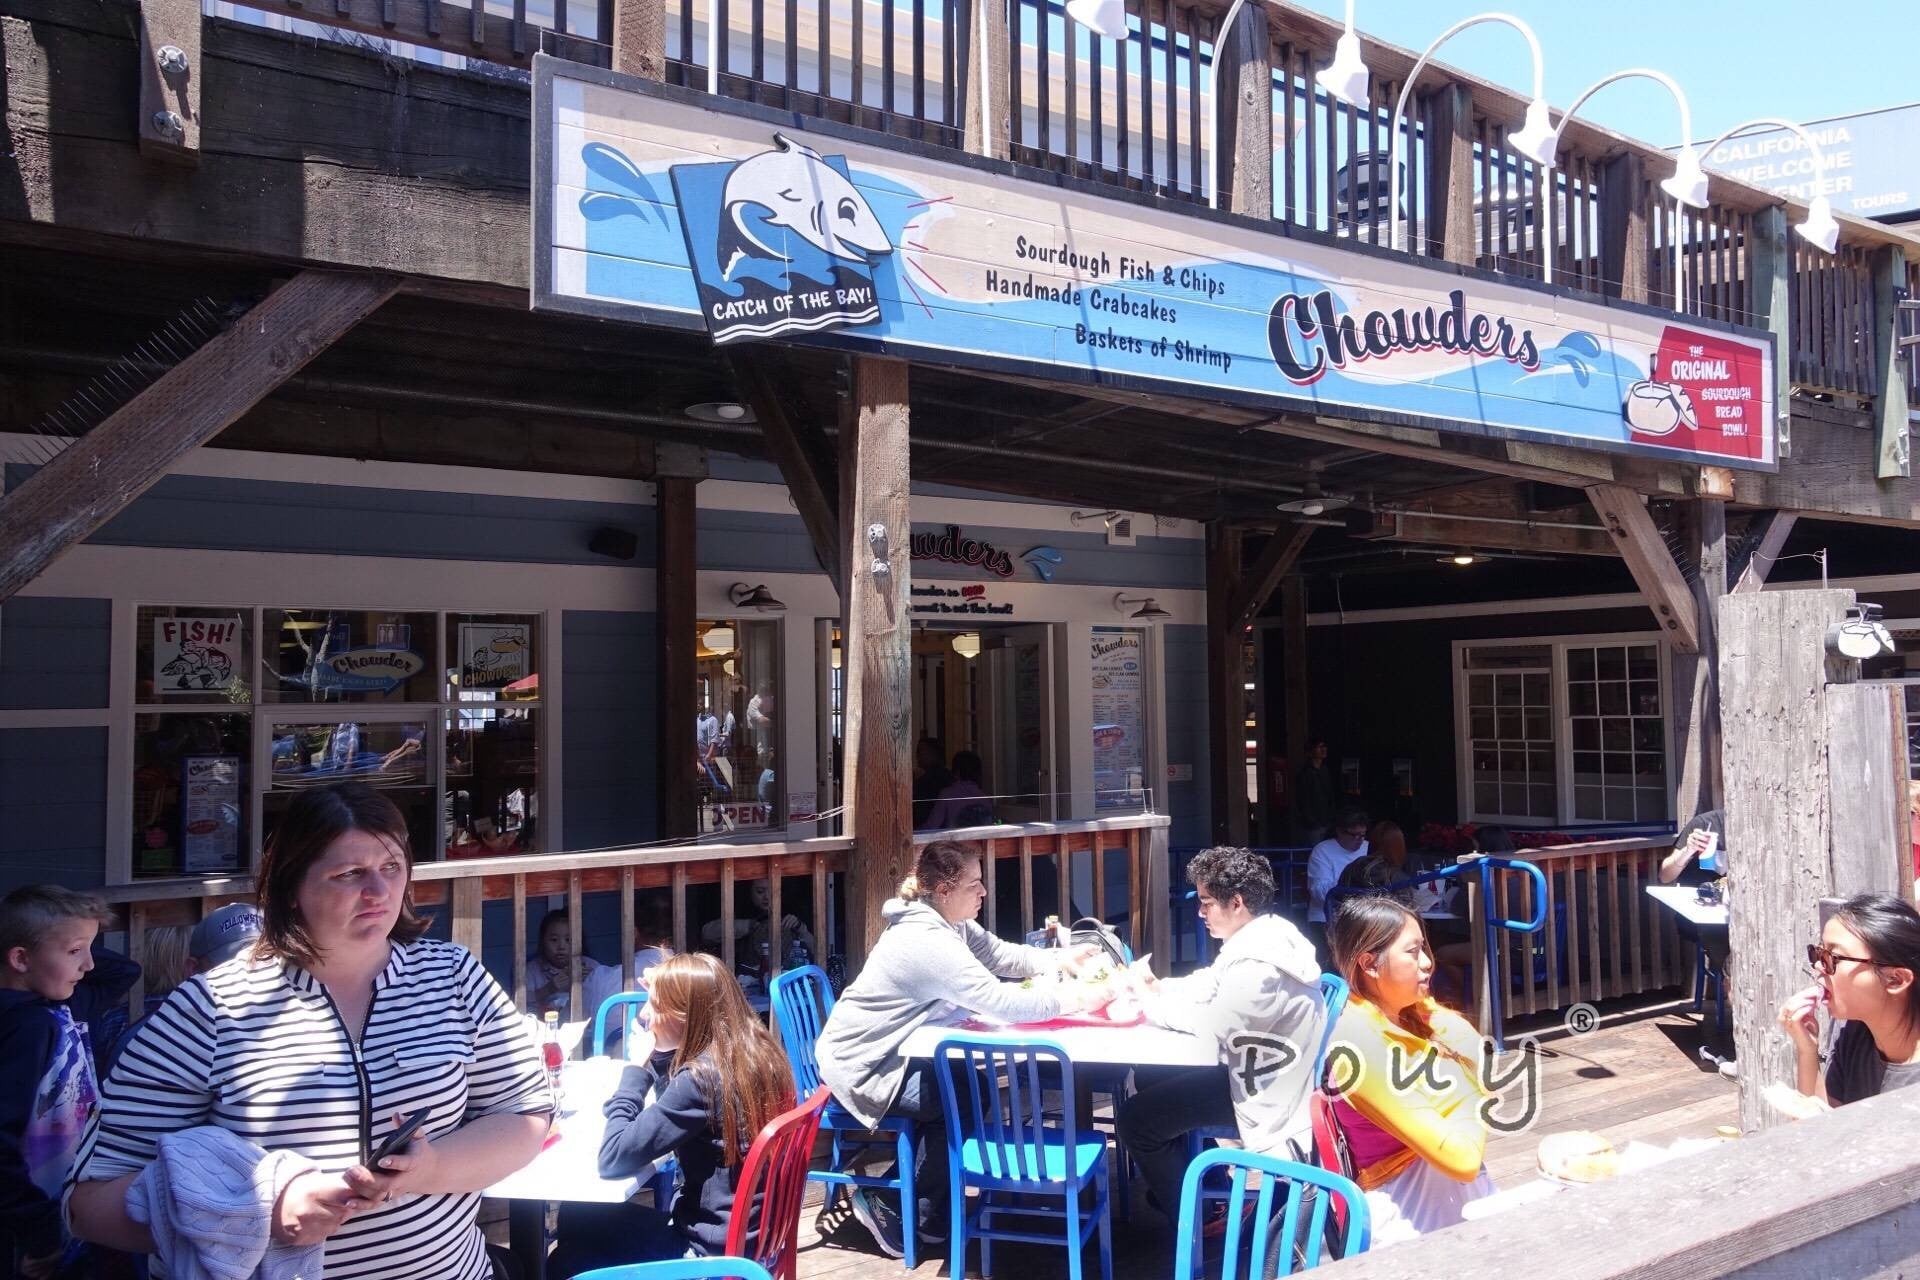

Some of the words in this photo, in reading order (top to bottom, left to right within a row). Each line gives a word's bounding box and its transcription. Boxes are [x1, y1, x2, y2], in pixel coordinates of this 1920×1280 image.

[1850, 192, 1908, 209] TOURS
[1015, 235, 1110, 278] Sourdough
[1120, 257, 1155, 282] Fish
[1163, 265, 1175, 286] &
[1180, 268, 1225, 300] Chips
[713, 299, 768, 320] CATCH
[773, 294, 793, 312] OF
[798, 291, 831, 309] THE
[835, 286, 872, 306] BAY!
[986, 269, 1081, 307] Handmade
[1090, 288, 1176, 324] Crabcakes
[1268, 288, 1541, 386] Chowders
[1075, 322, 1142, 354] Baskets
[1151, 336, 1167, 357] of
[1174, 340, 1232, 374] Shrimp
[1689, 345, 1704, 357] THE
[1671, 360, 1731, 380] ORIGINAL
[1701, 386, 1751, 401] SOURDOUGH
[1715, 405, 1743, 418] BREAD
[1722, 423, 1748, 436] BOWL!
[163, 620, 235, 645] FISH!
[332, 652, 413, 674] Chowder
[713, 806, 765, 826] OPEN
